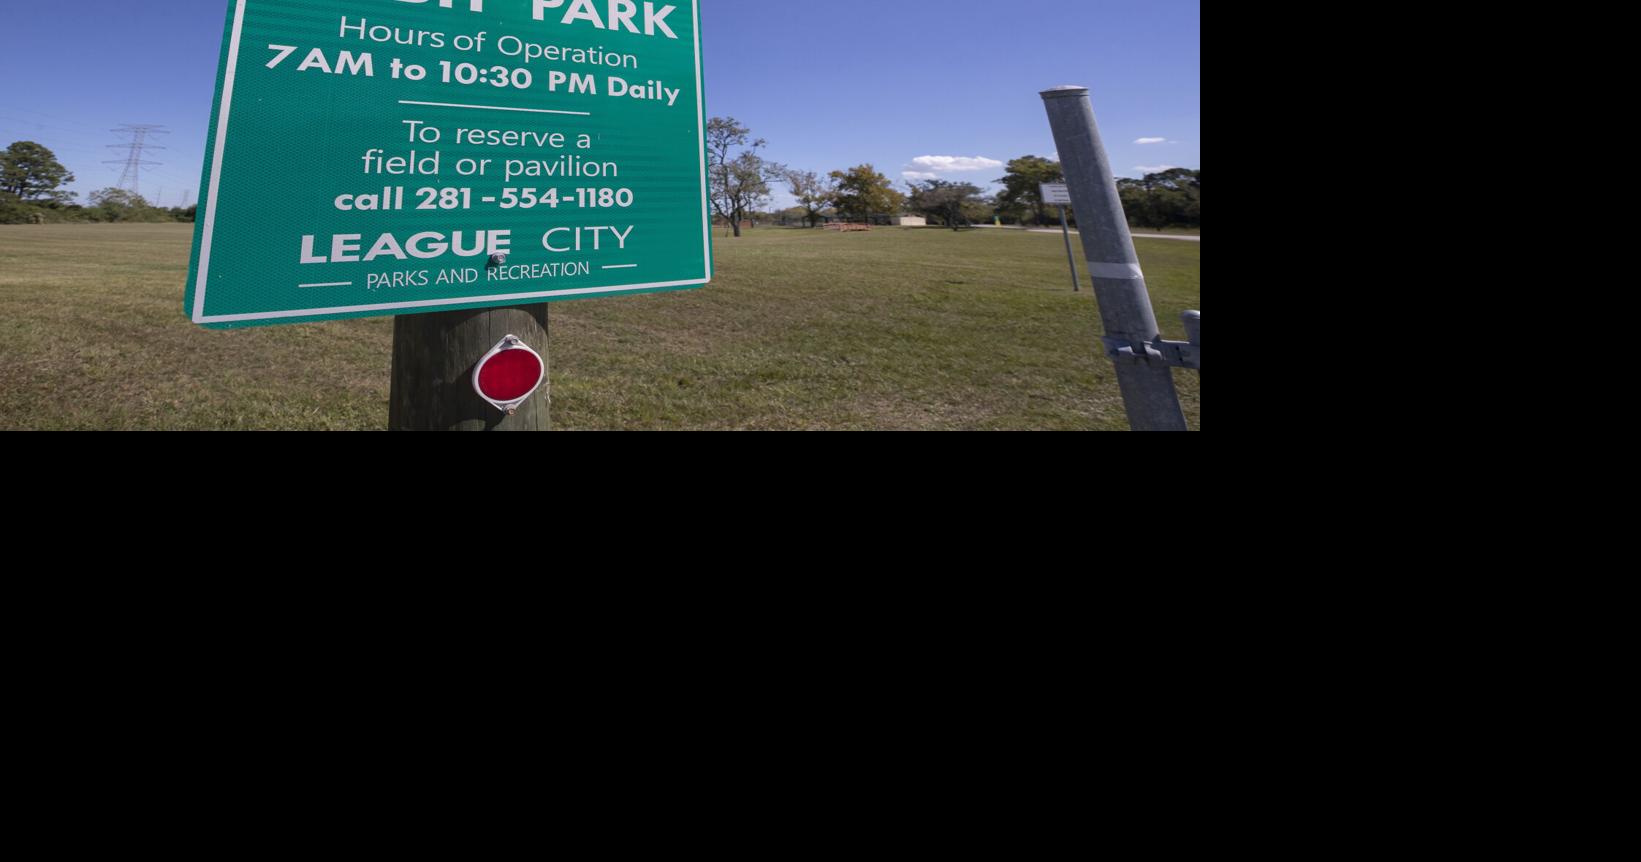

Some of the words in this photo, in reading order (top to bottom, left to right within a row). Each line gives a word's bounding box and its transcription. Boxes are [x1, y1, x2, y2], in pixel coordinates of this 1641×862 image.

[339, 15, 445, 48] Hours
[453, 31, 487, 52] of
[497, 35, 638, 69] Operation
[265, 43, 374, 77] 7AM
[390, 57, 427, 82] to
[439, 60, 533, 89] 10:30
[548, 70, 597, 95] PM
[607, 76, 680, 106] Daily
[402, 119, 441, 143] To
[456, 128, 566, 149] reserve
[577, 133, 591, 149] a
[361, 148, 440, 175] field
[456, 158, 493, 176] or
[505, 154, 618, 183] pavilion
[334, 186, 404, 211] call
[299, 229, 511, 264] LEAGUE
[541, 225, 634, 252] CITY
[367, 270, 429, 289] PARKS
[435, 267, 478, 286] AND
[487, 261, 589, 281] RECREATION
